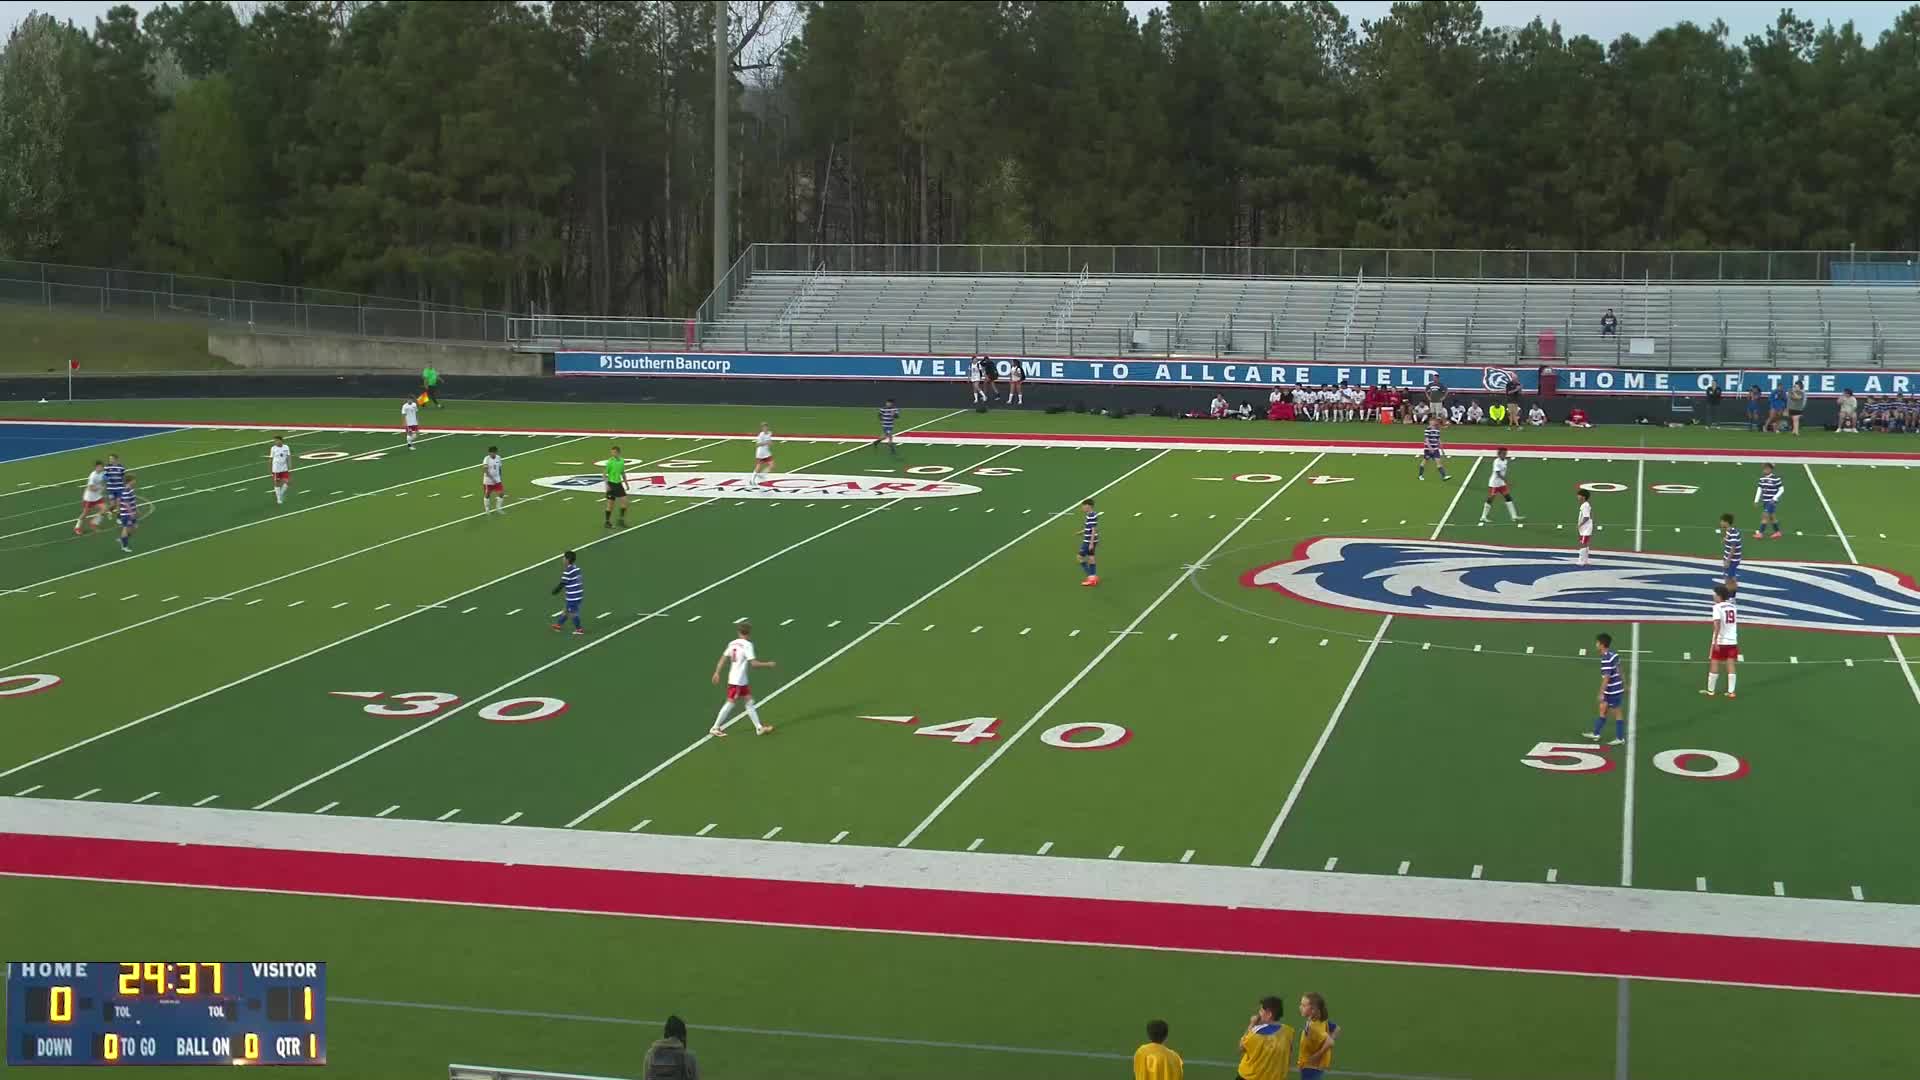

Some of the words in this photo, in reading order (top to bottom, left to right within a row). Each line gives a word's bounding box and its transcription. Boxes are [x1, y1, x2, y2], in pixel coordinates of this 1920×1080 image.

[901, 359, 1064, 378] WELOME
[1090, 363, 1129, 379] TO
[1155, 364, 1310, 383] ALLCARE
[1569, 371, 1669, 389] HOME
[1697, 374, 1740, 391] OF
[1725, 609, 1735, 624] 19
